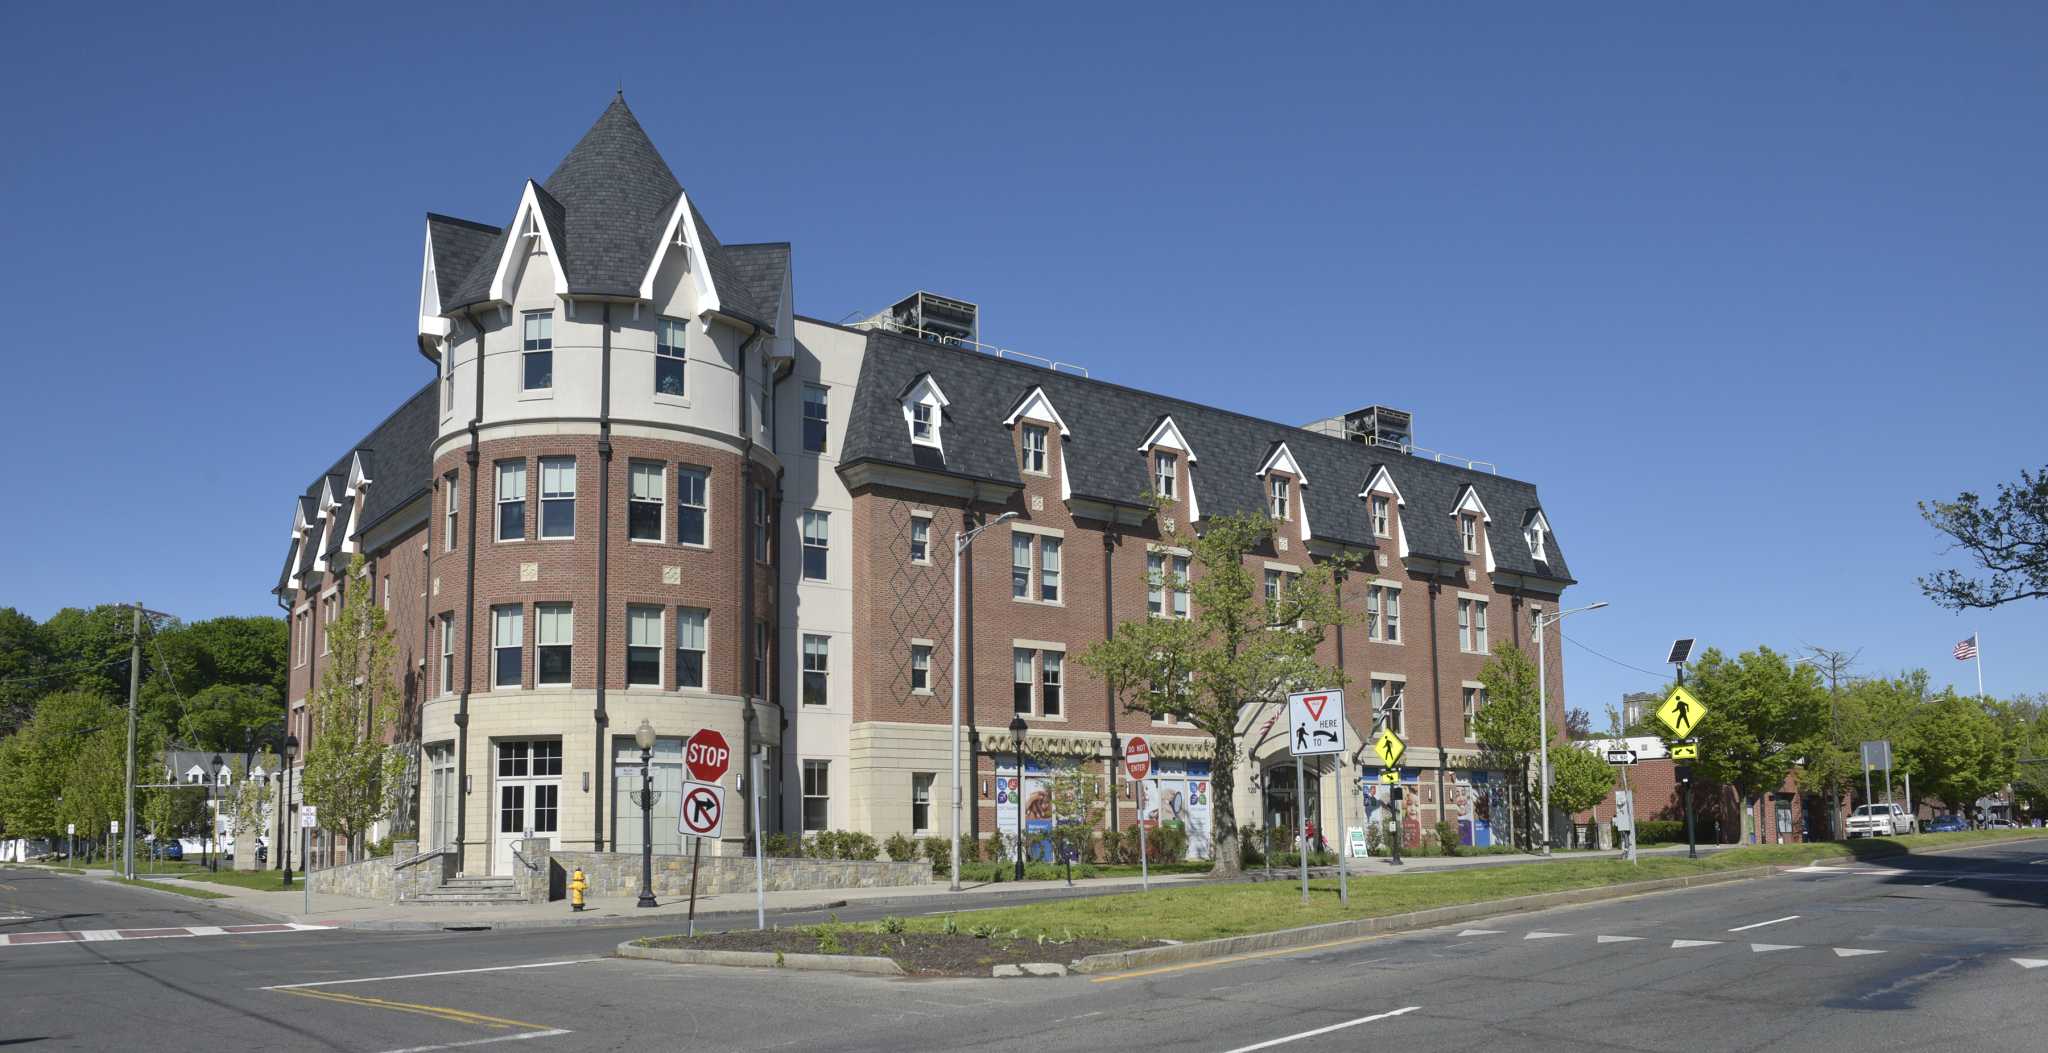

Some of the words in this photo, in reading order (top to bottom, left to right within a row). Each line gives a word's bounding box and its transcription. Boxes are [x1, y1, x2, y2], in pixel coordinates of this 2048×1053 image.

[1319, 719, 1338, 728] HERE
[1313, 738, 1322, 747] TO
[1136, 744, 1146, 752] NOT
[688, 743, 728, 768] STOP
[1130, 763, 1146, 772] ENTER
